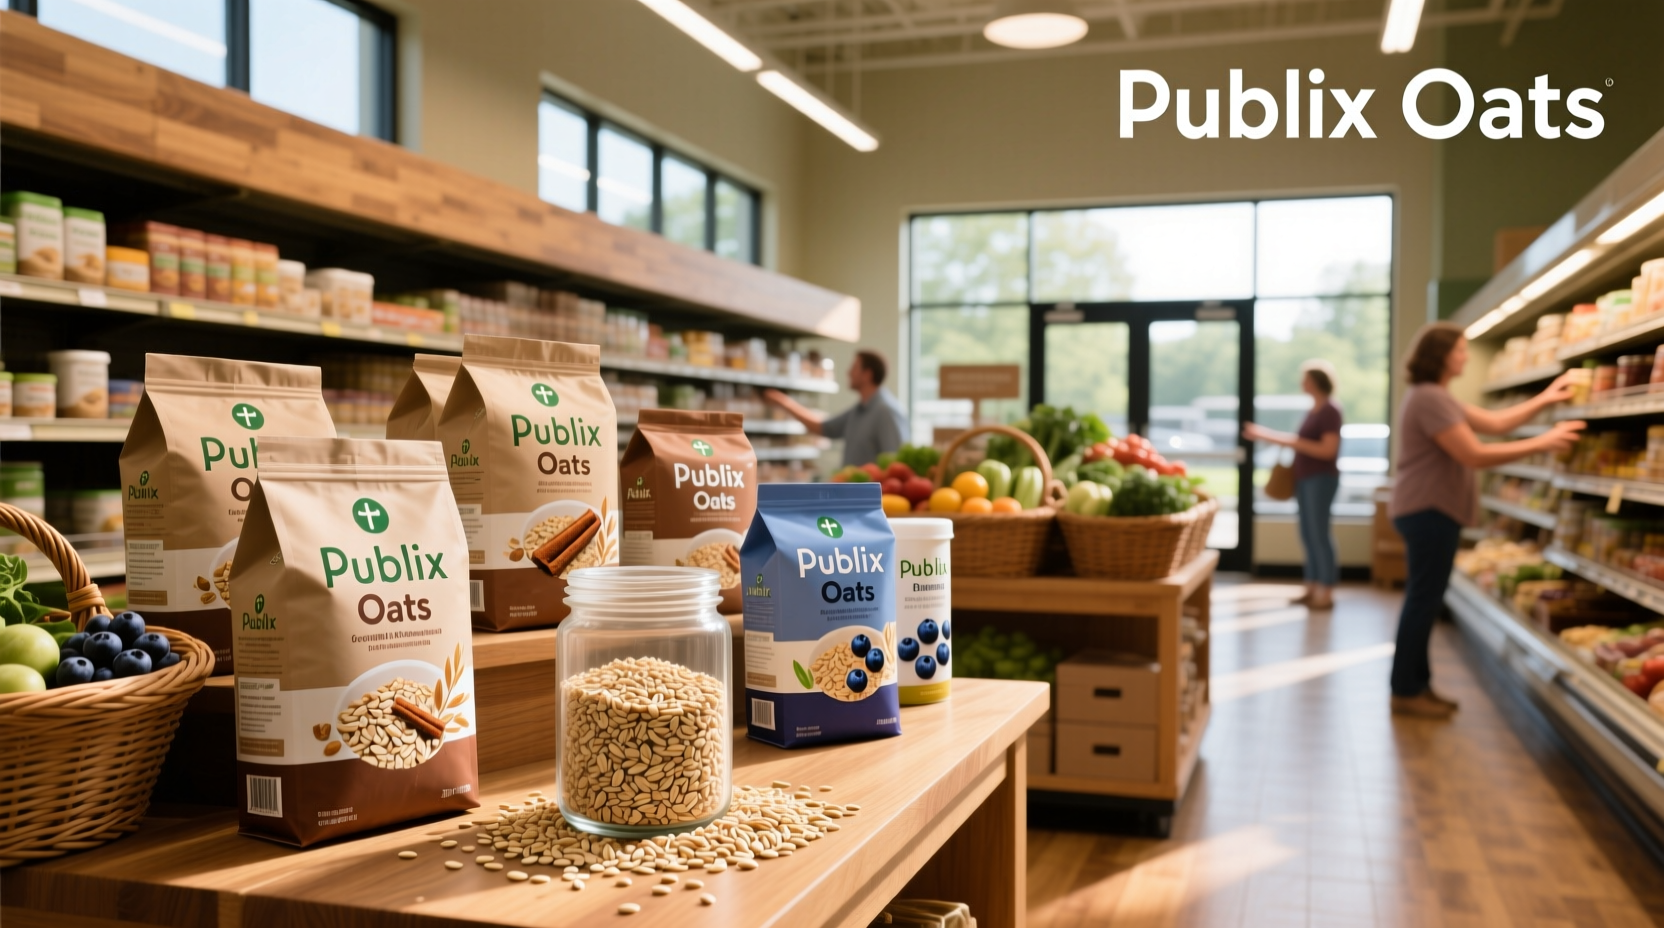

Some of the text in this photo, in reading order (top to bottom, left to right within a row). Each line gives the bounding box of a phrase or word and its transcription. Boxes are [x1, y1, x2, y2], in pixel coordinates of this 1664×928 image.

[511, 414, 602, 447] Publix
[537, 451, 591, 475] Oats
[674, 462, 745, 489] Publix
[693, 491, 736, 510] Oats
[320, 543, 448, 588] Publix
[797, 546, 885, 578] Publix
[821, 580, 875, 603] Oats
[357, 593, 432, 625] Oats
